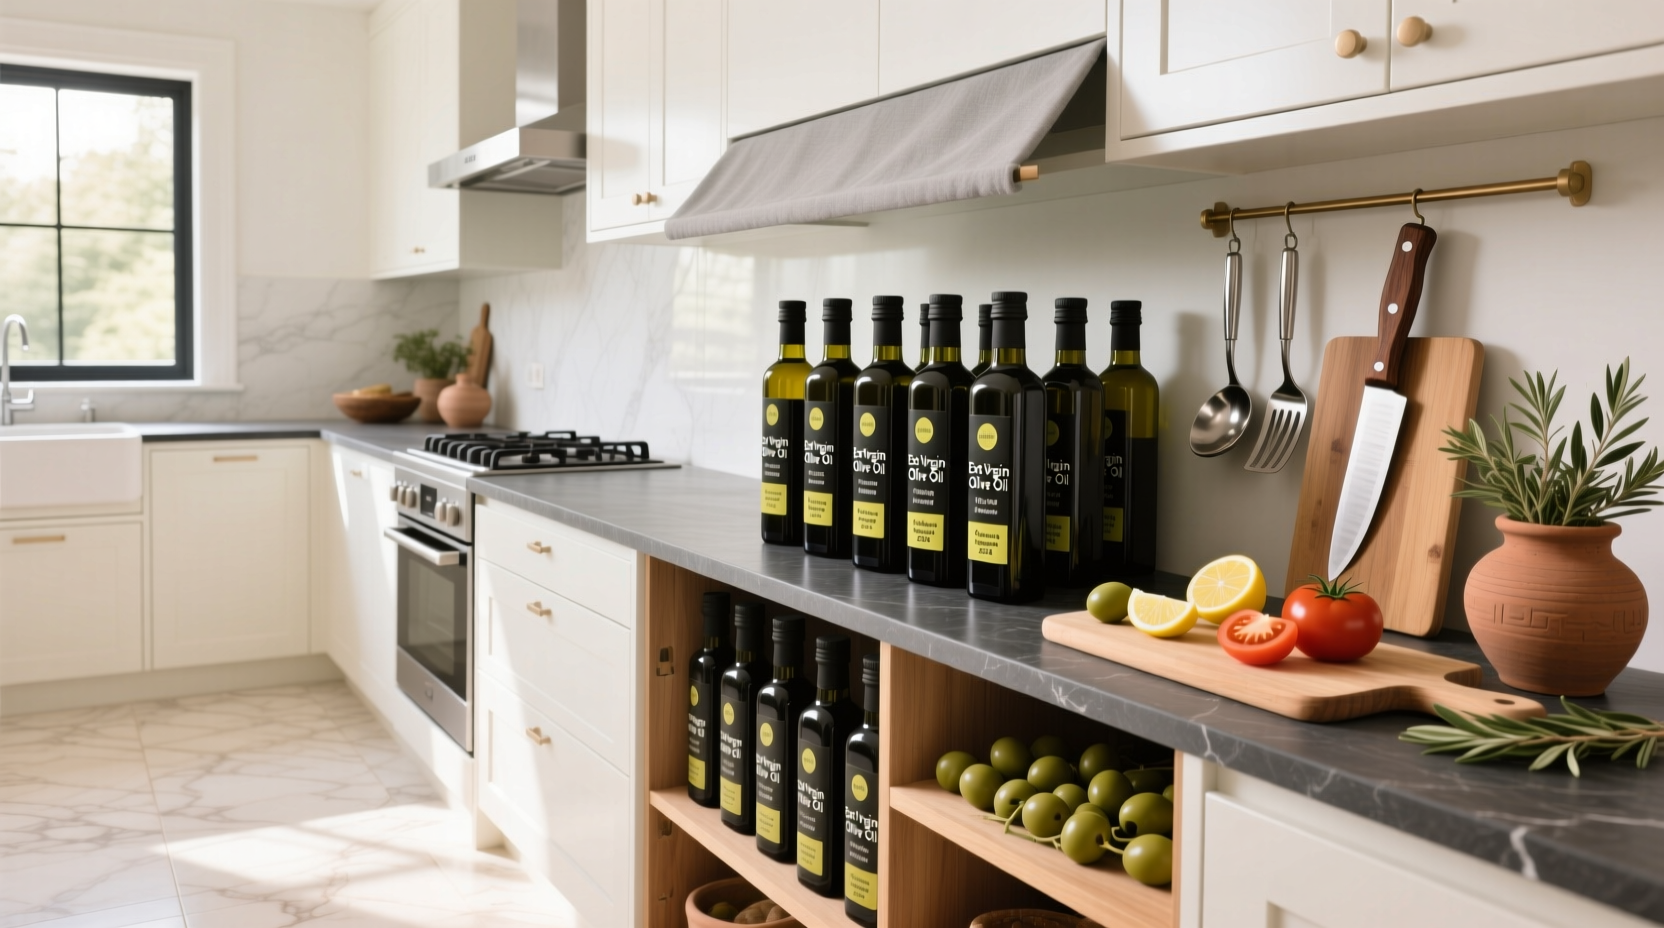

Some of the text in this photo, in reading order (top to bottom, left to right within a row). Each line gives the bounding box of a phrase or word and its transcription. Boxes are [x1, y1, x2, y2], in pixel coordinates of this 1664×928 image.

[822, 454, 833, 465] Oil
[873, 462, 885, 475] Oil
[929, 470, 944, 483] Oil
[1055, 473, 1069, 486] Oil
[993, 478, 1008, 492] Oil
[865, 829, 878, 843] Oil
